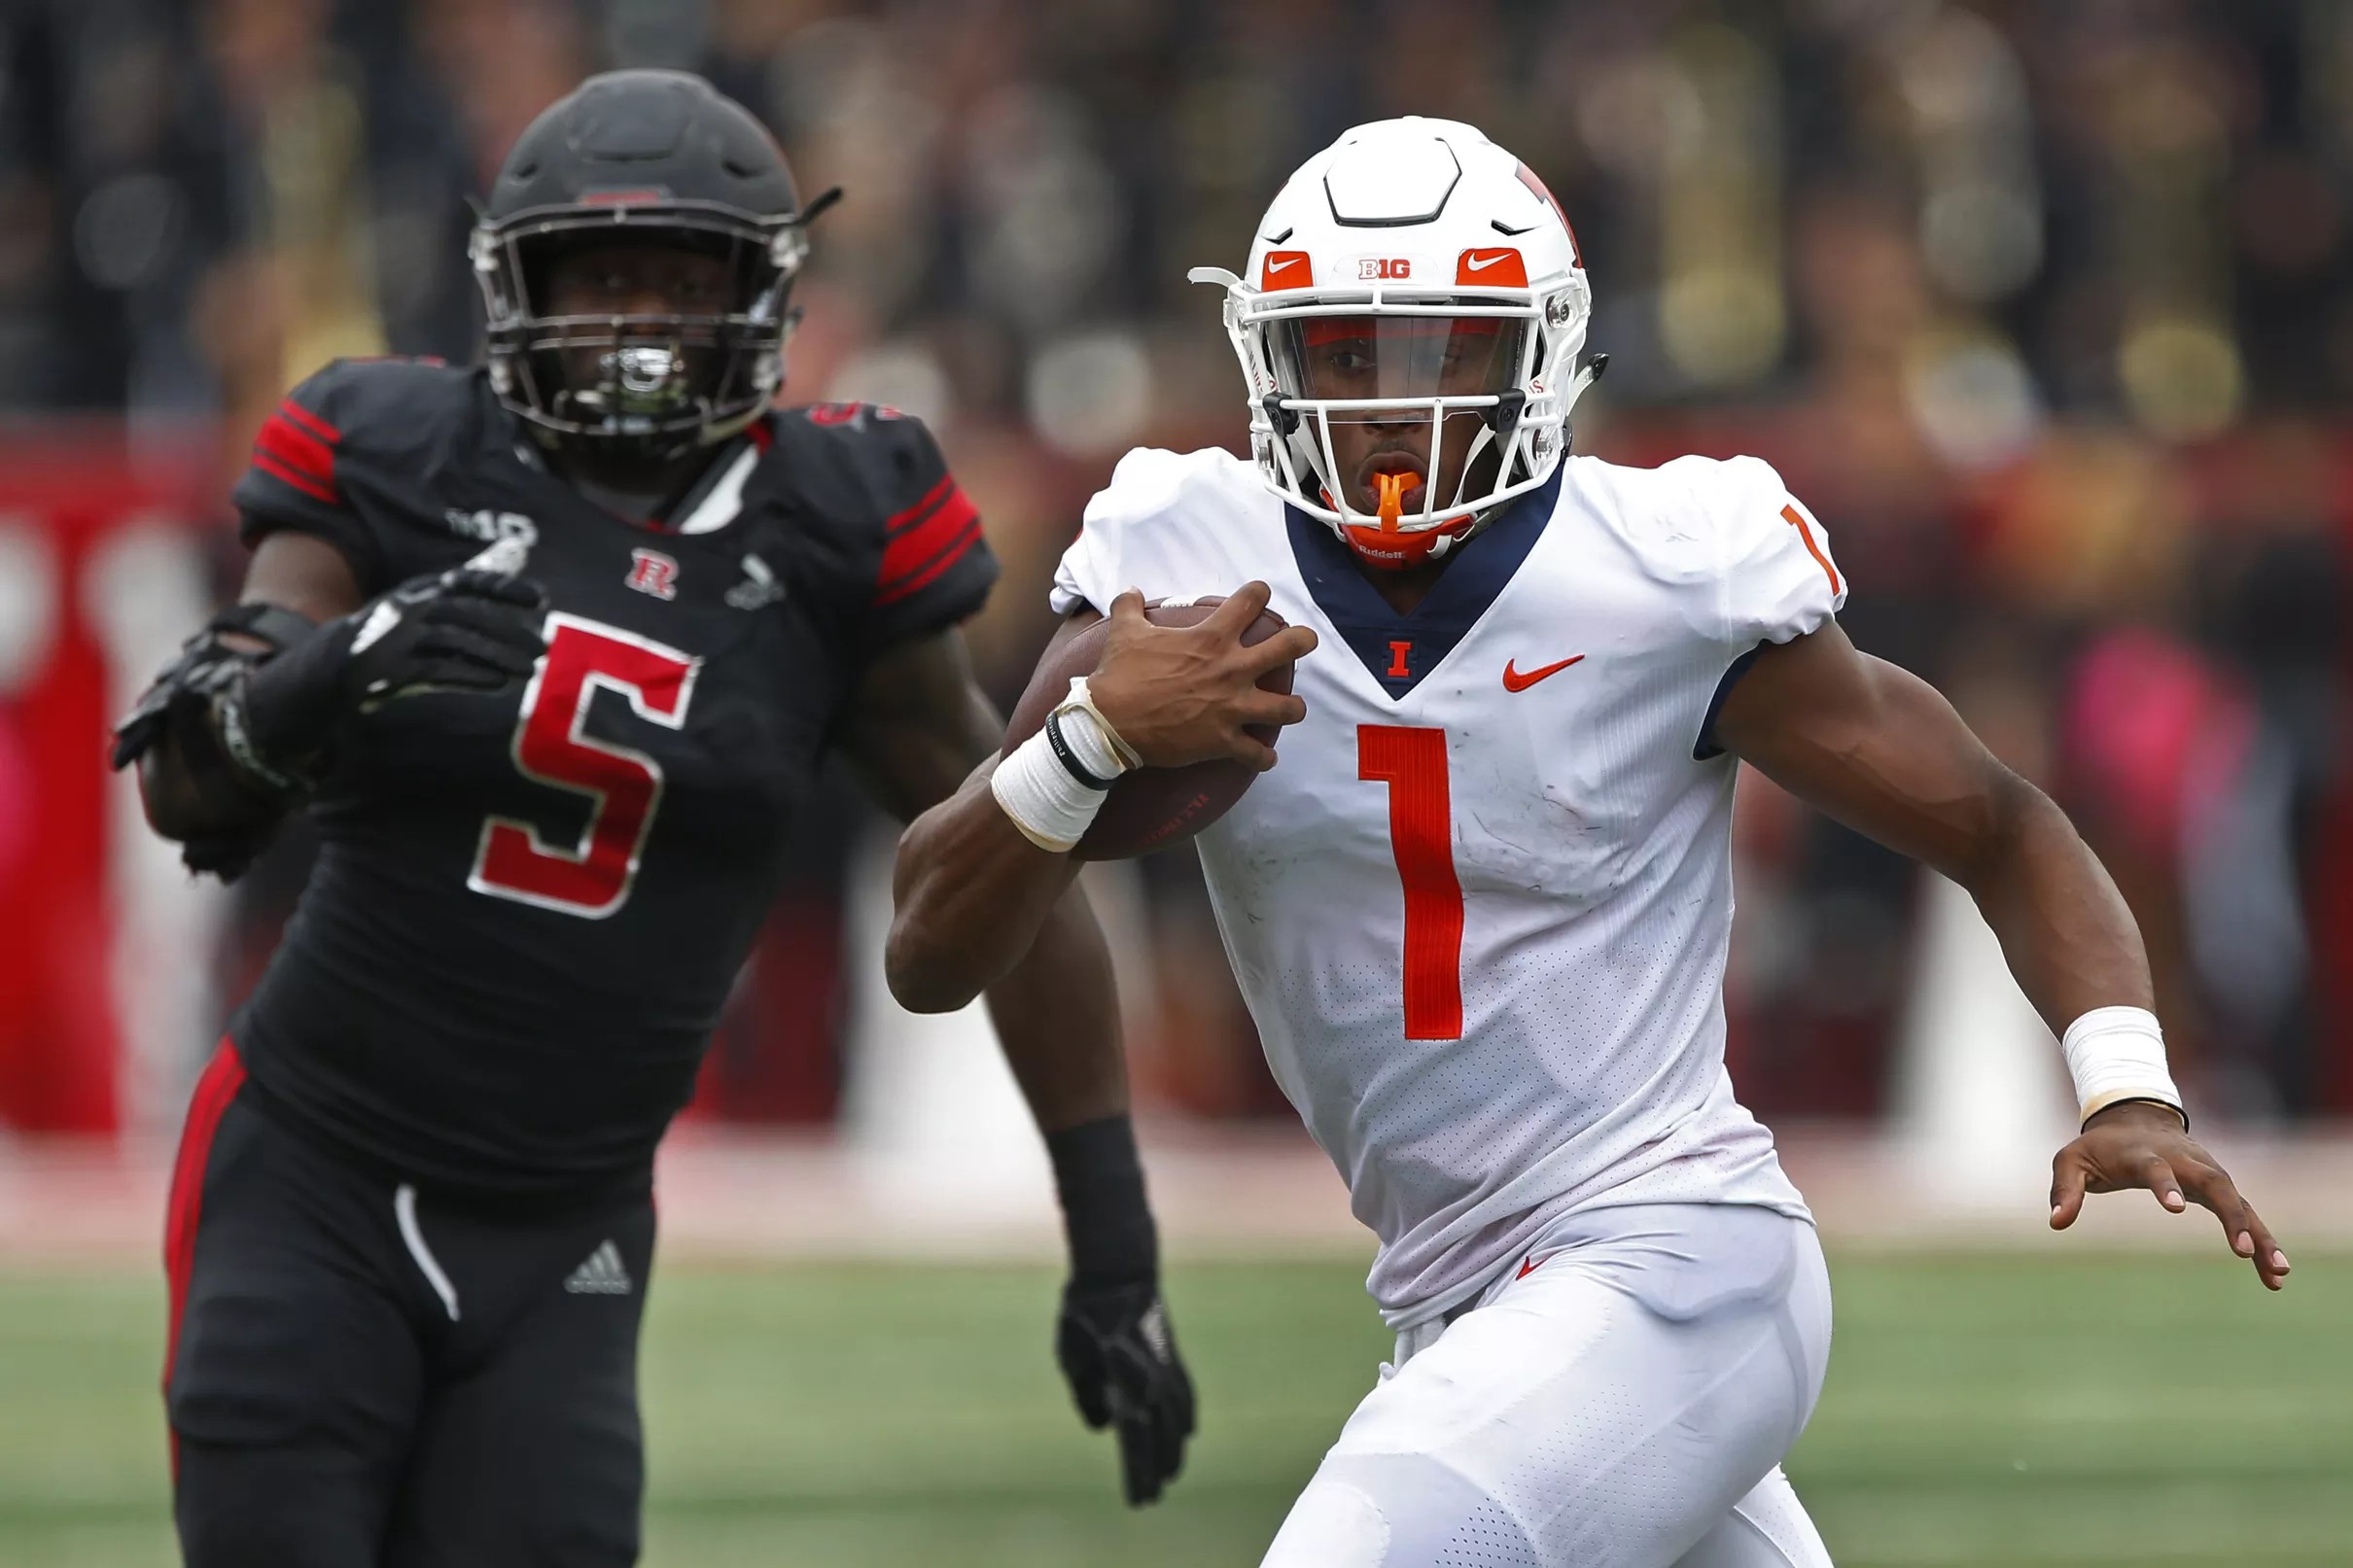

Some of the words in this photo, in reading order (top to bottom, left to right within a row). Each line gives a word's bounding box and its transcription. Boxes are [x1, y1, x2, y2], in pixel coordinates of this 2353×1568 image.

[623, 546, 680, 601] R
[1358, 544, 1402, 559] Riddell
[1780, 504, 1841, 596] 1
[1387, 641, 1412, 678] I
[467, 610, 705, 921] 5
[1356, 724, 1465, 1041] 1
